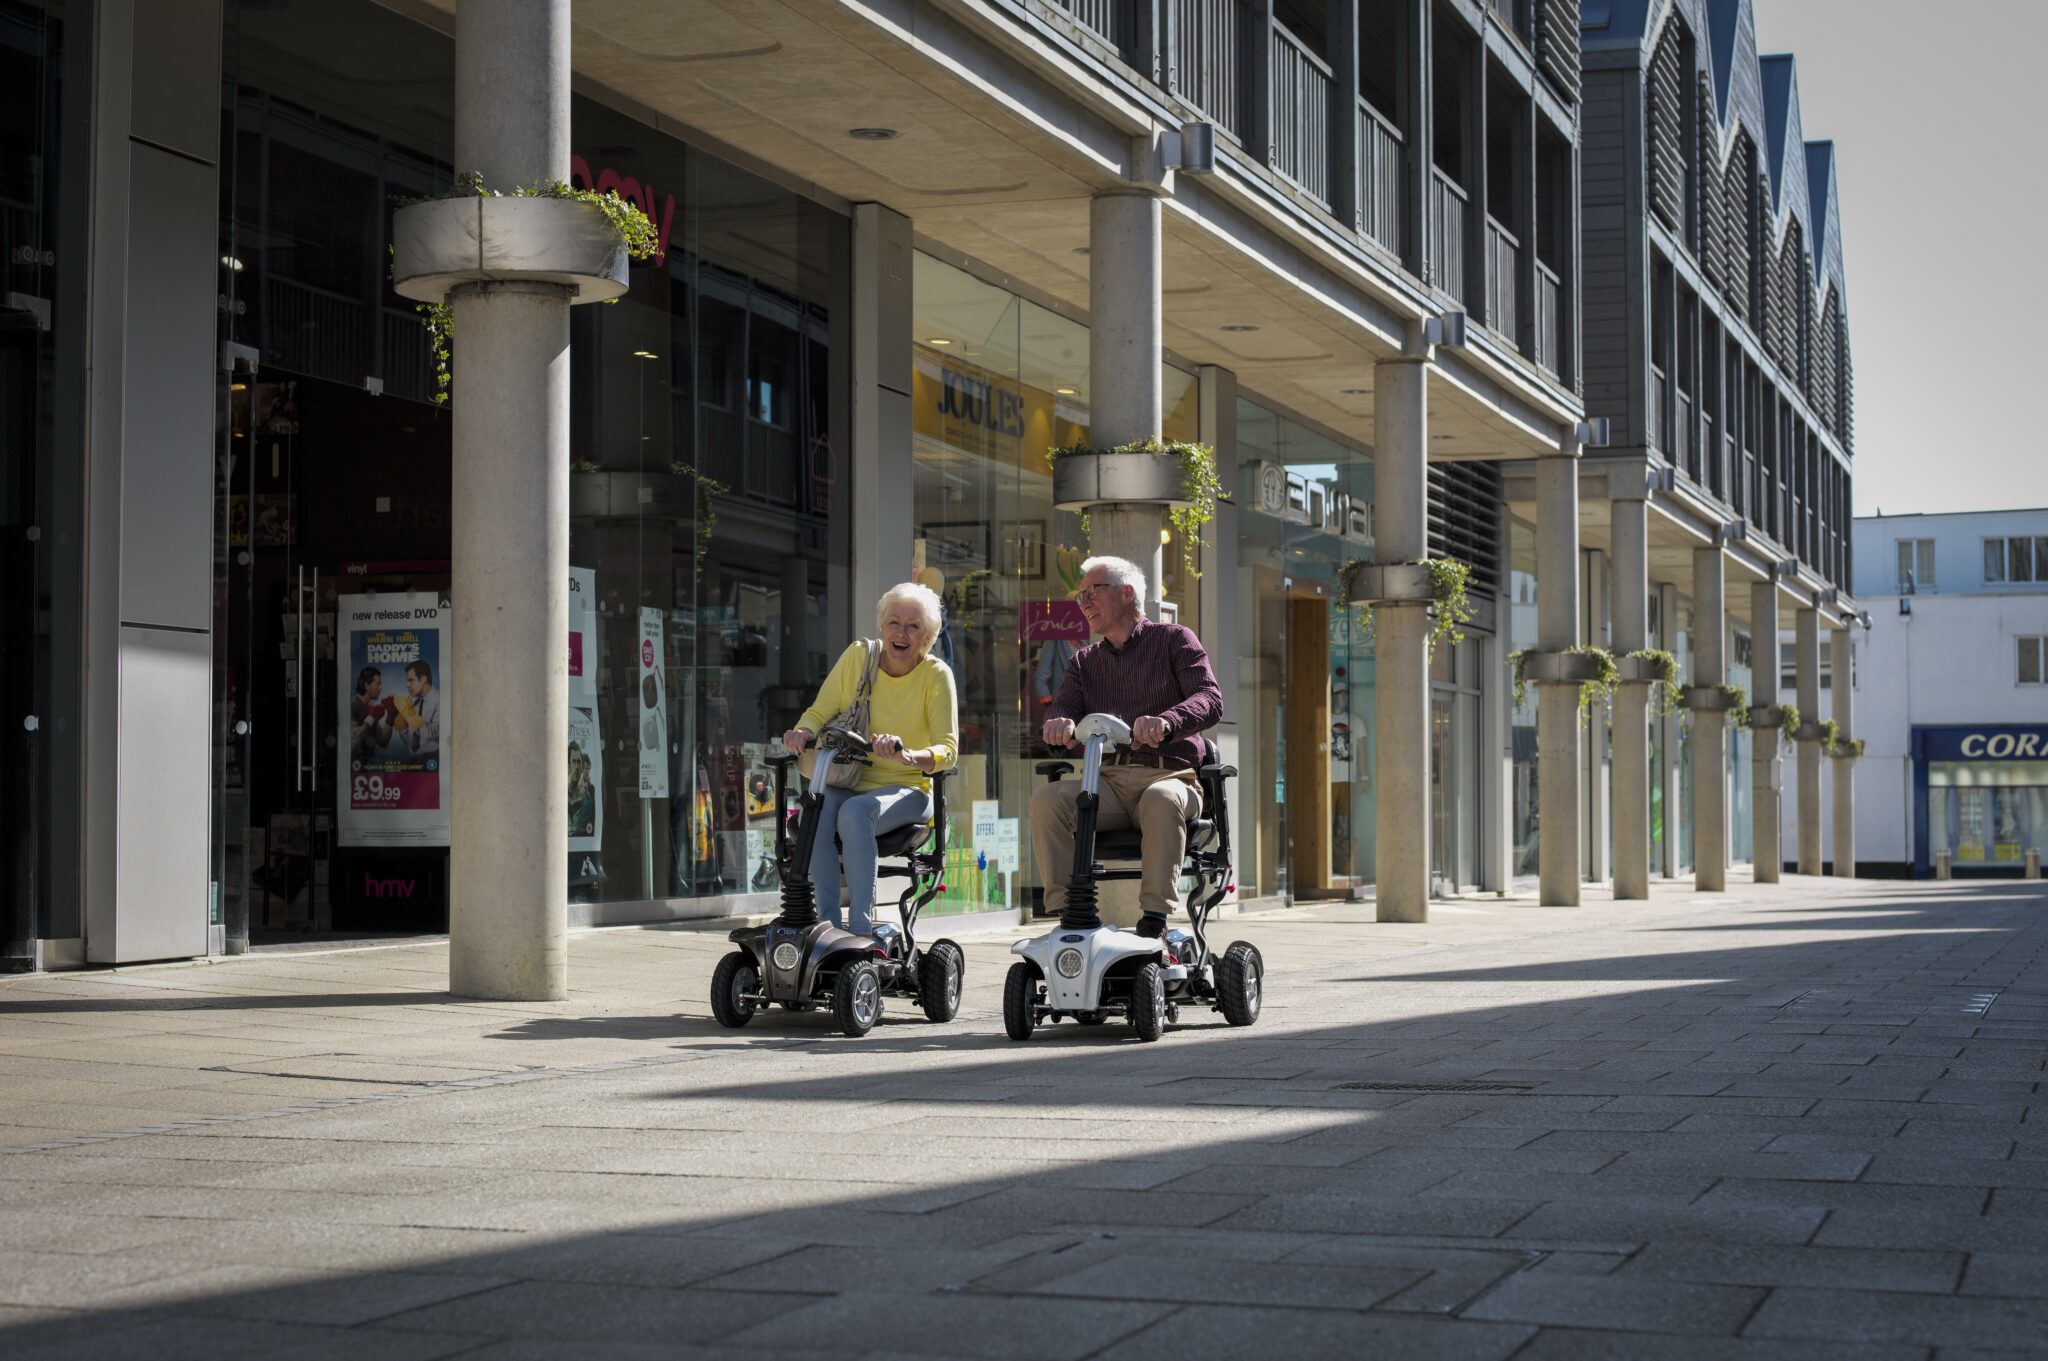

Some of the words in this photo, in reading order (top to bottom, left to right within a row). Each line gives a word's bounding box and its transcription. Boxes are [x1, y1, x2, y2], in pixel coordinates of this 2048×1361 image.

[937, 367, 1025, 439] JOULES
[346, 563, 368, 576] vinyl
[352, 612, 372, 620] new
[375, 609, 411, 620] release
[414, 608, 438, 619] DVD
[367, 643, 420, 652] DADDY'S
[367, 652, 420, 664] HOME
[353, 775, 401, 801] £9.99
[365, 871, 416, 897] hmv
